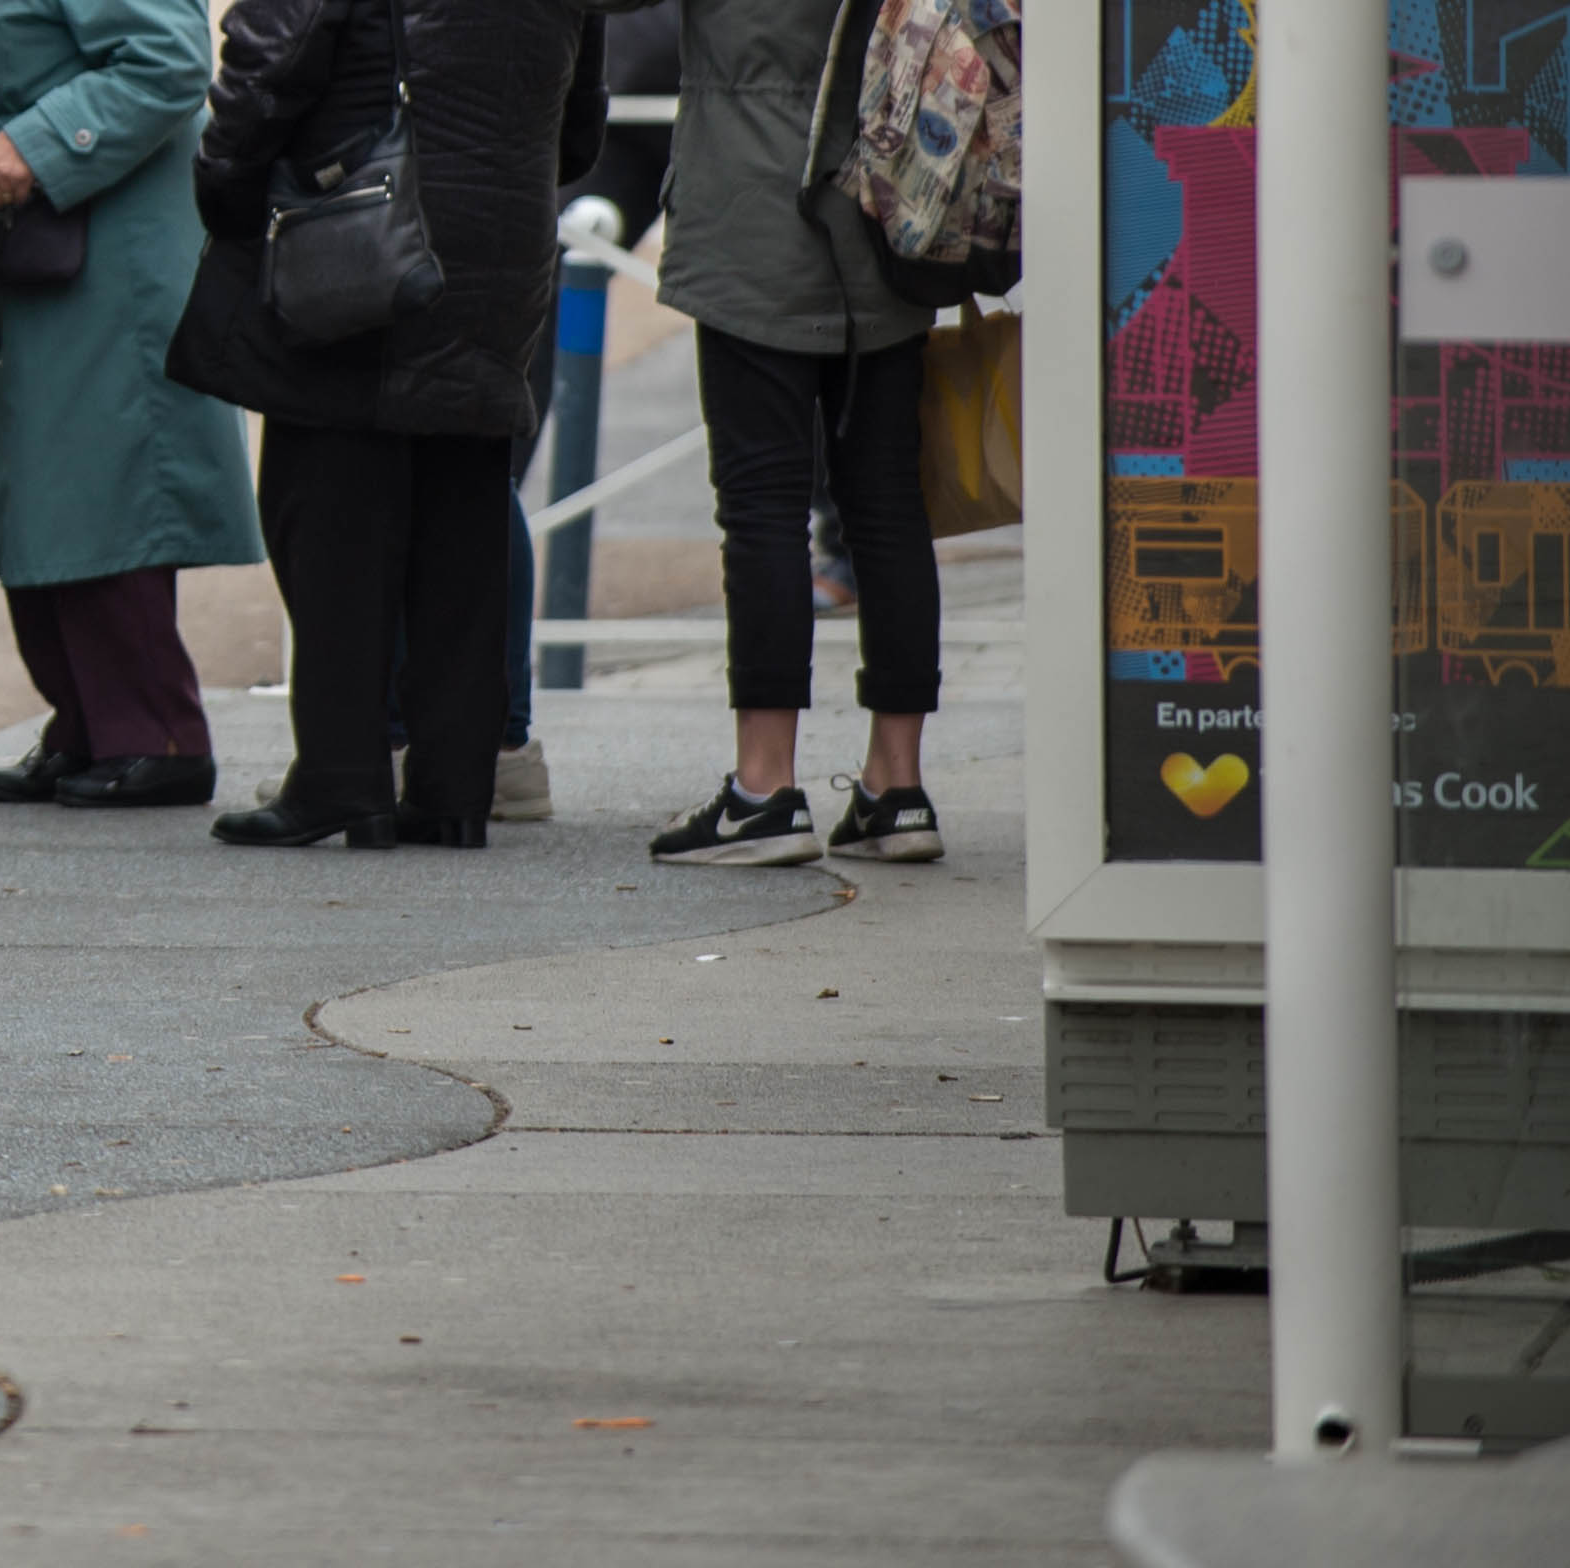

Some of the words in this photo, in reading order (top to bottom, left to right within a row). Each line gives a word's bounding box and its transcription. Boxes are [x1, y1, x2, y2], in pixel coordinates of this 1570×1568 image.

[1157, 702, 1192, 729] En
[1433, 772, 1540, 811] Cook
[894, 807, 929, 828] NIKE
